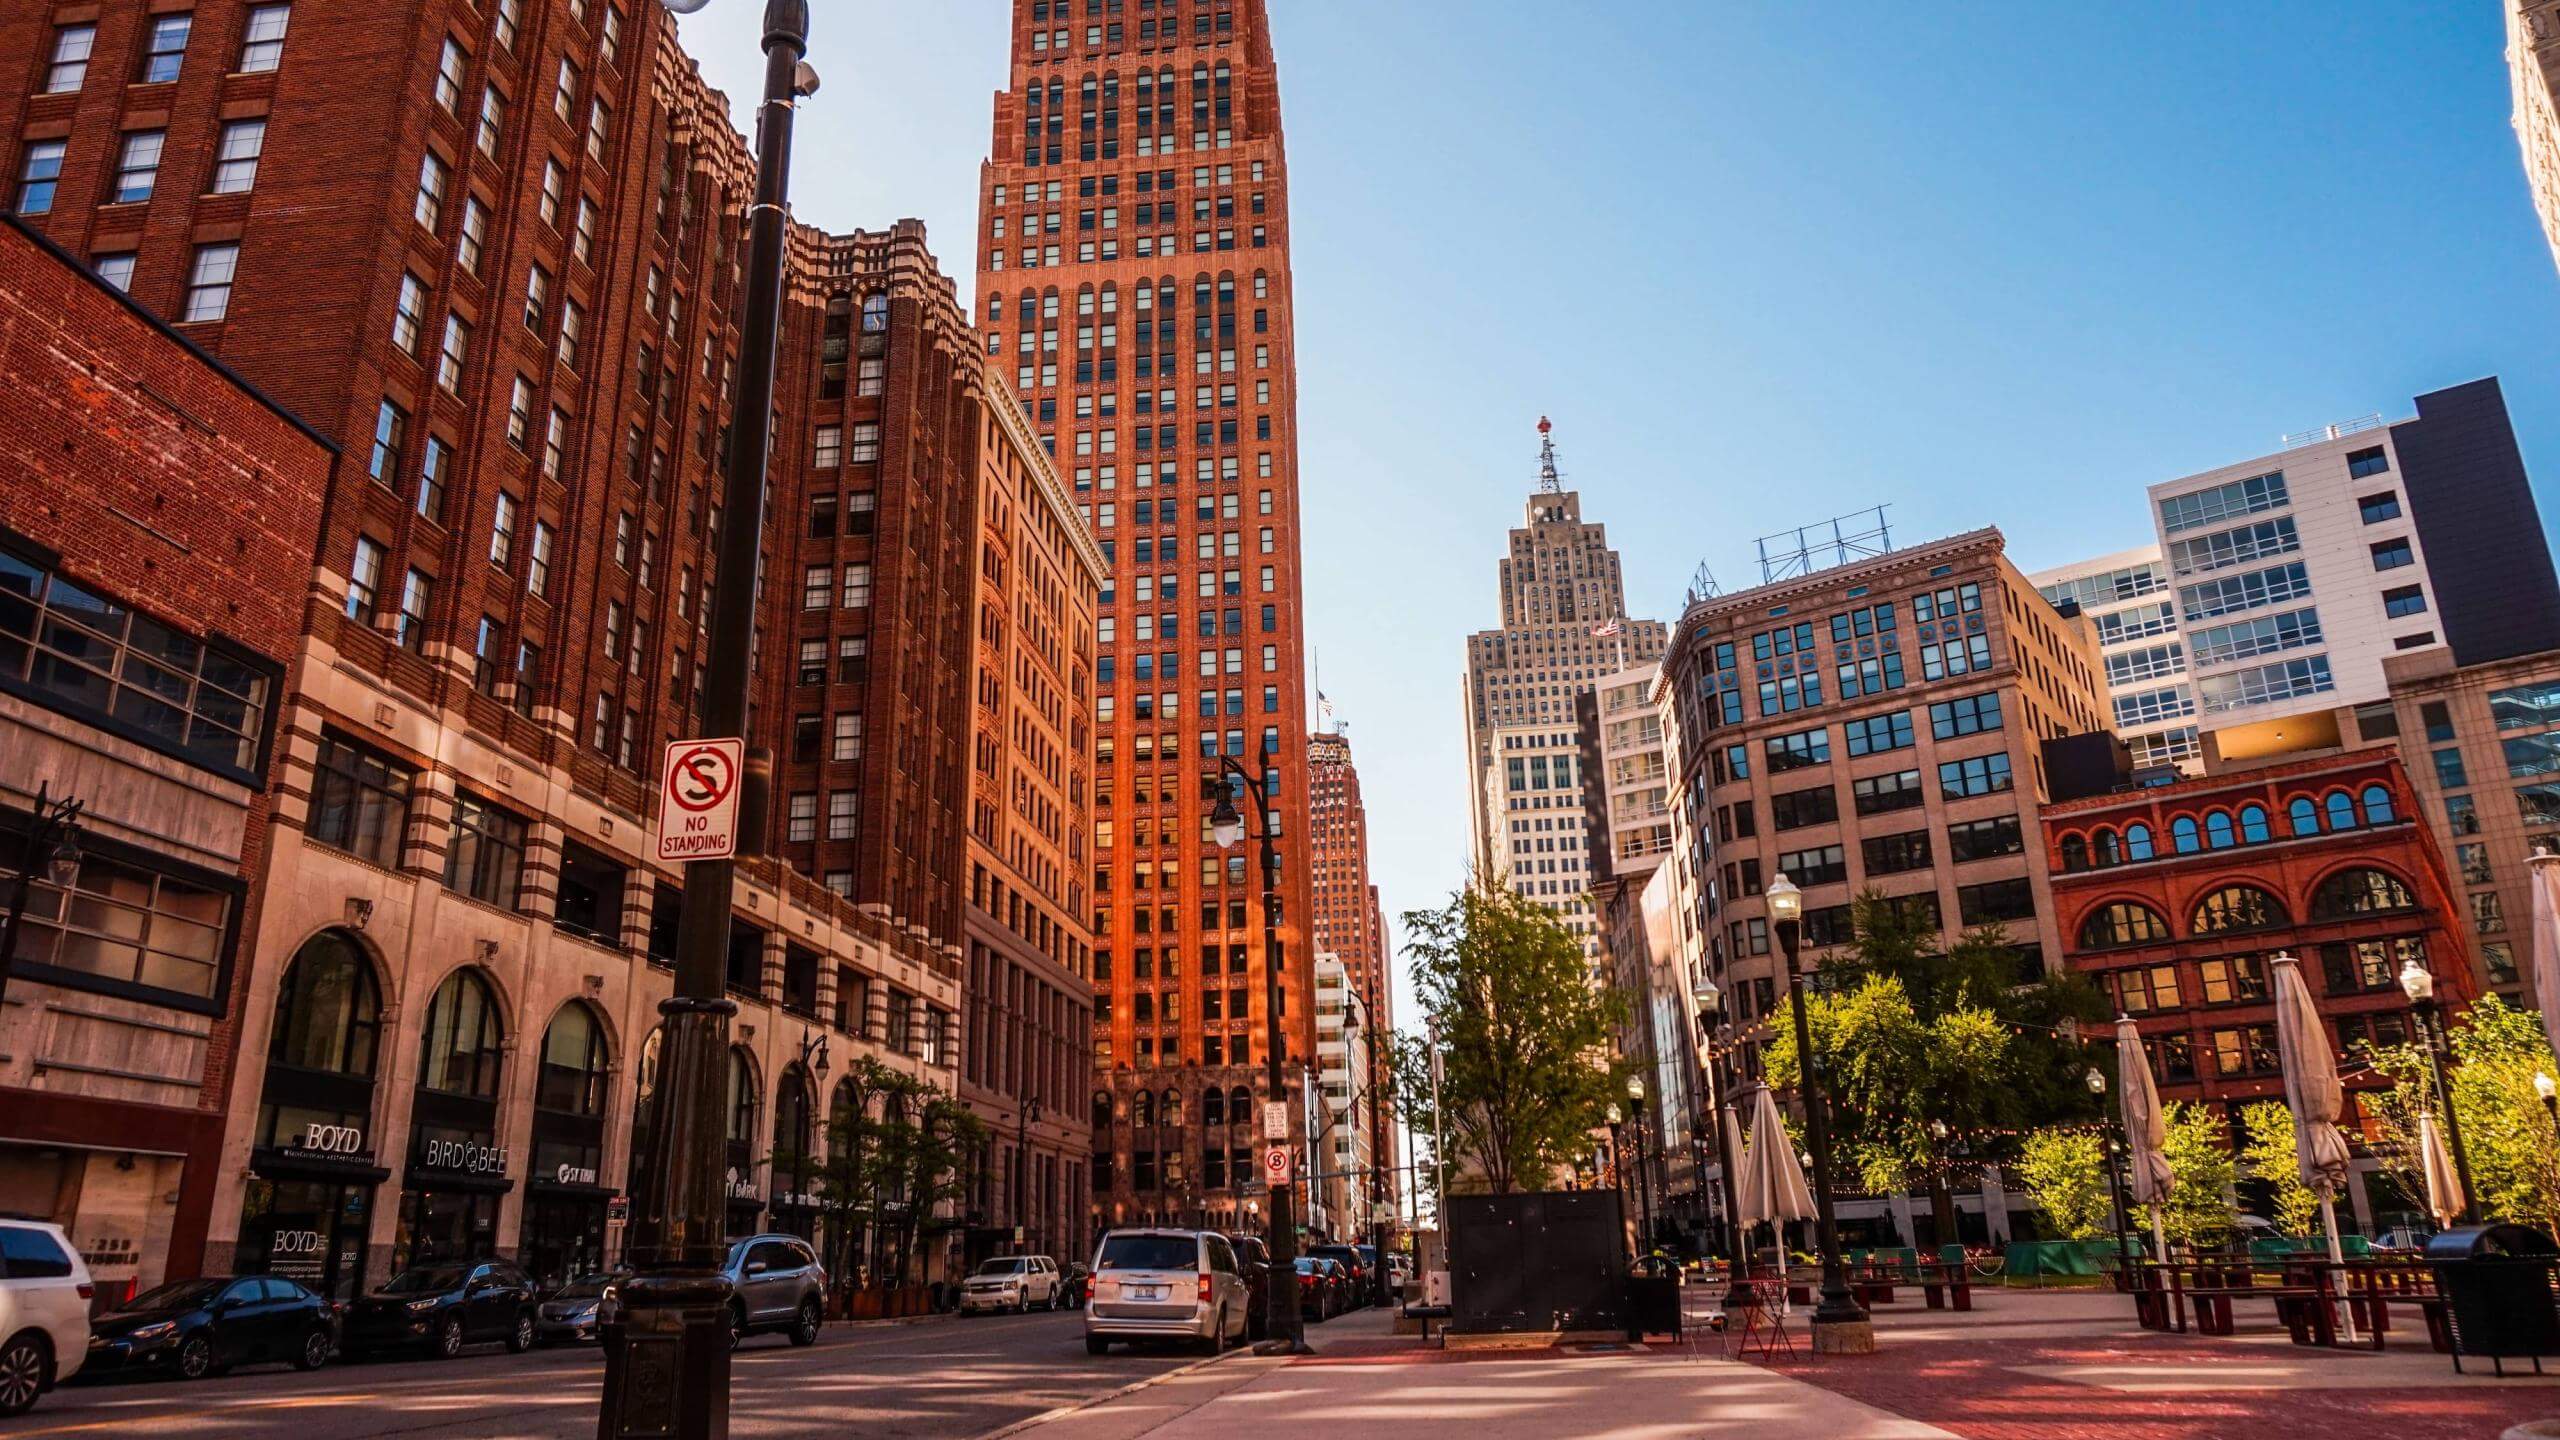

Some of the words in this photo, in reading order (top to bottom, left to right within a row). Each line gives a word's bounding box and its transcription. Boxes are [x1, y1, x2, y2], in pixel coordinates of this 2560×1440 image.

[686, 817, 707, 832] NO
[664, 834, 726, 852] STANDING
[303, 1123, 361, 1153] BOYD
[427, 1140, 465, 1168] BIRD
[478, 1147, 508, 1173] BEE
[735, 1180, 758, 1199] BARK
[272, 1230, 318, 1252] BOYD
